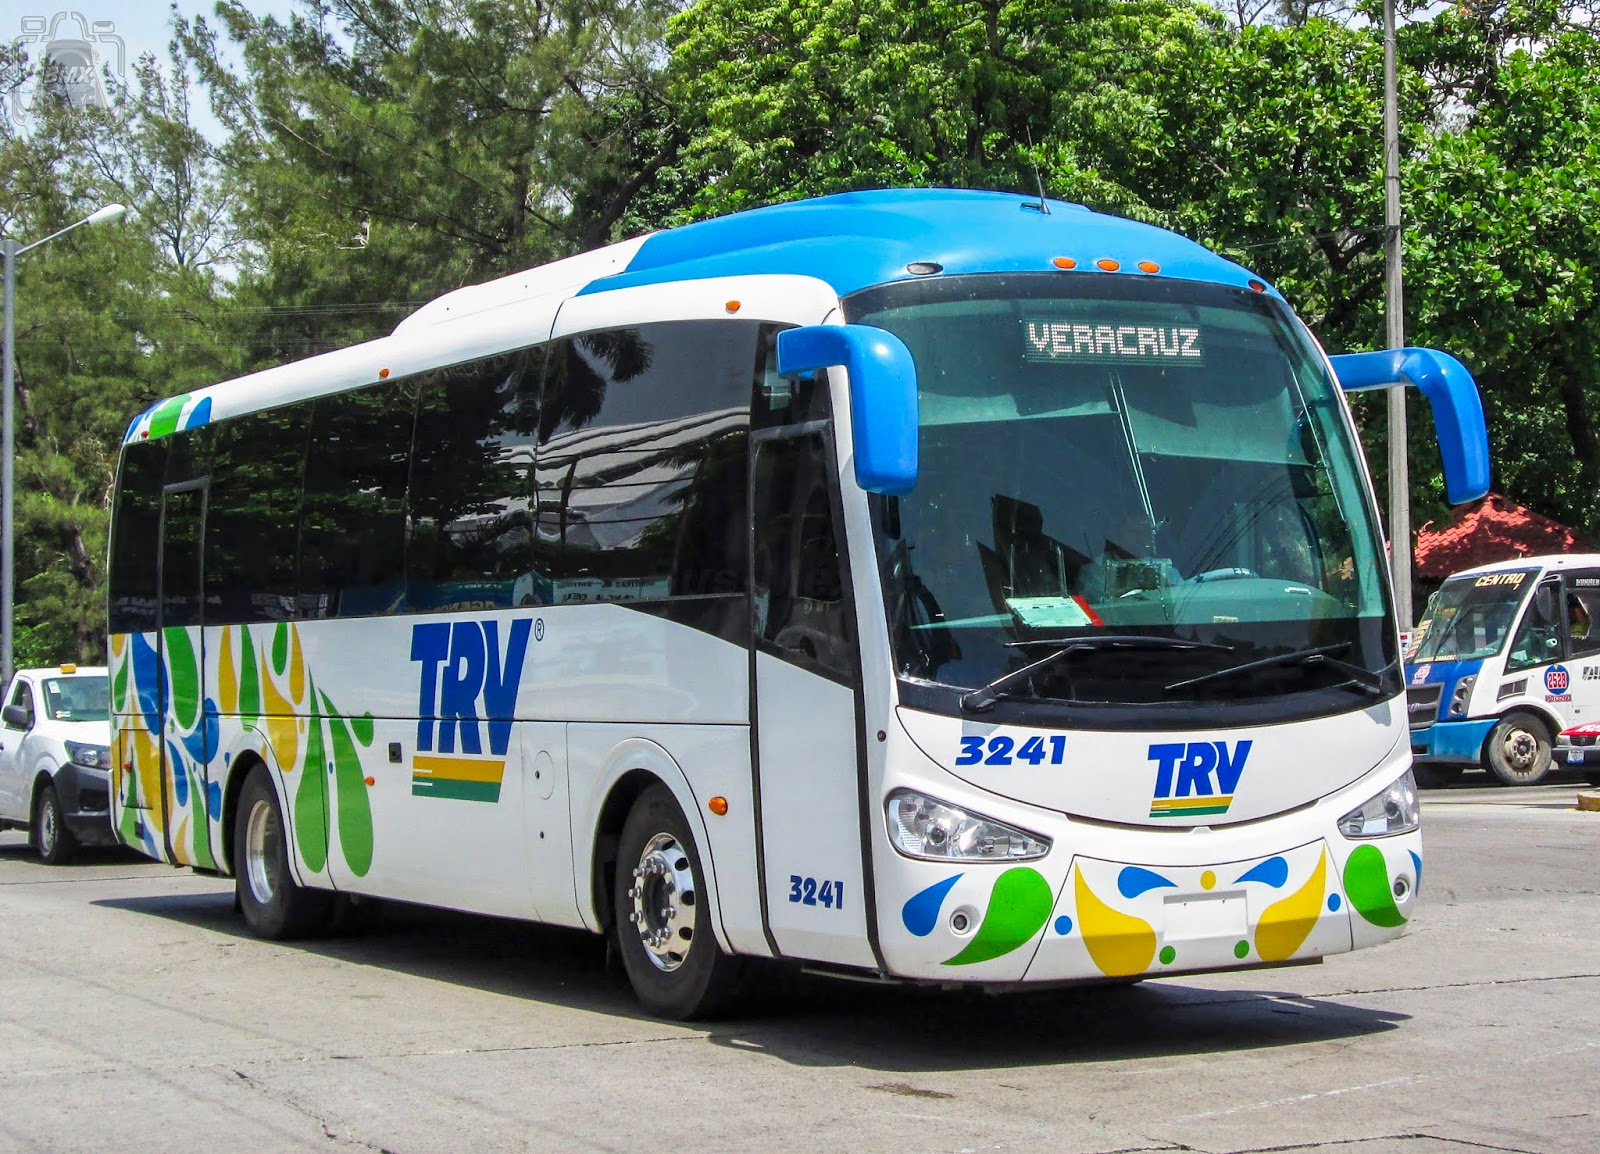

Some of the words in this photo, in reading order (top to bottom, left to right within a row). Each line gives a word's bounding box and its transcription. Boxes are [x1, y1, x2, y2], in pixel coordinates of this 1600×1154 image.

[1028, 322, 1201, 356] VERACRUZ
[1475, 572, 1526, 587] CENTRO
[410, 618, 533, 756] TRV
[955, 735, 1067, 766] 3241
[1147, 739, 1253, 798] TRV
[788, 874, 844, 910] 3241
